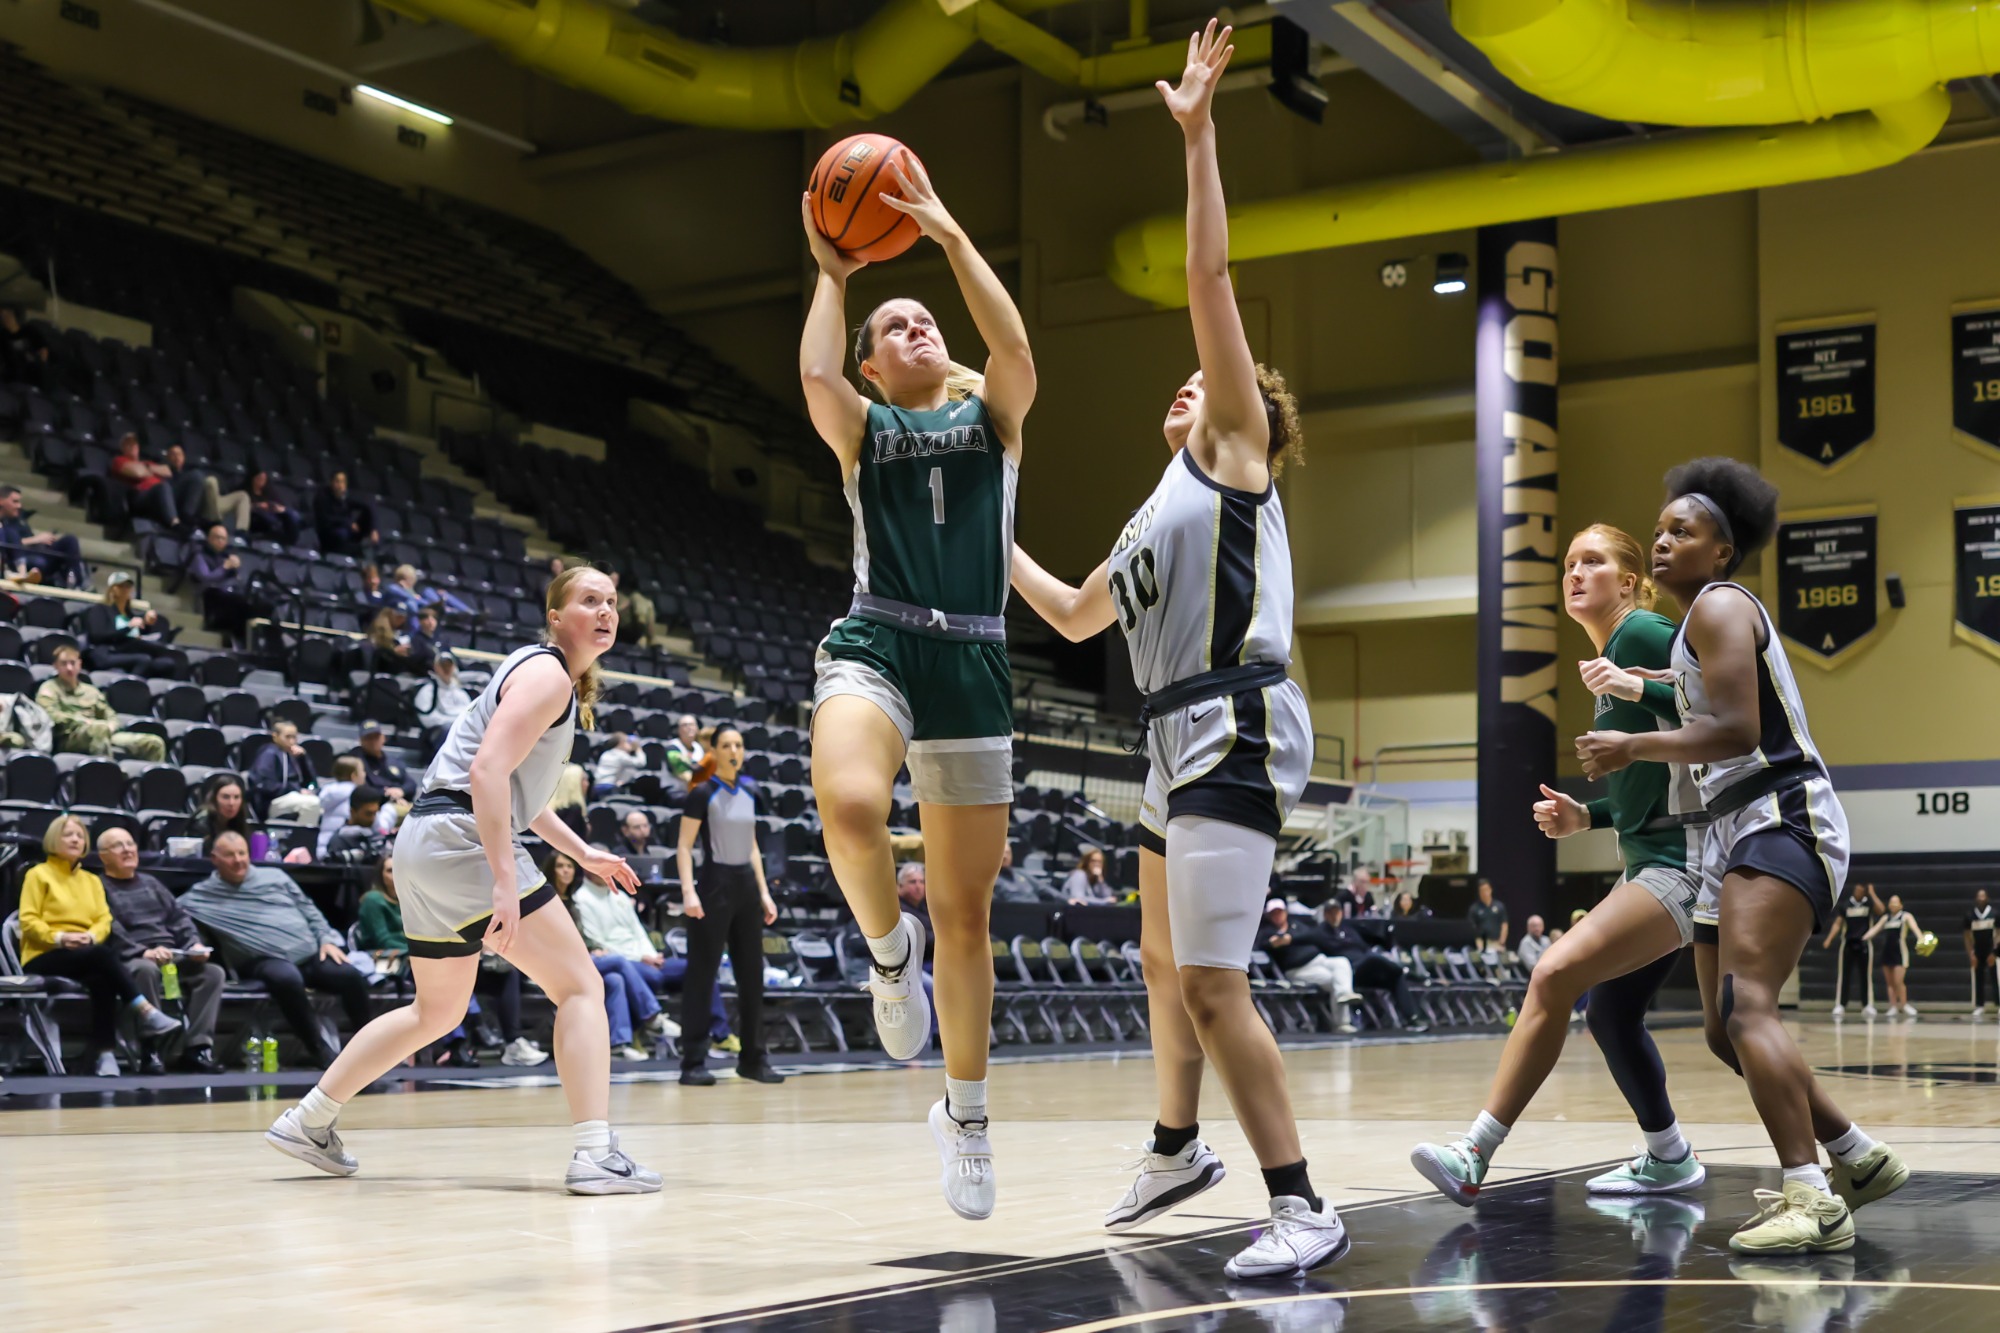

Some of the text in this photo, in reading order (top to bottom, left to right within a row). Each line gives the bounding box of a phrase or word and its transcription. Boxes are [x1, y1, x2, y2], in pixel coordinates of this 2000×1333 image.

[828, 142, 876, 204] ELITE
[1798, 394, 1855, 418] 1961
[874, 424, 988, 464] LOYOLA
[928, 466, 946, 524] 1
[1501, 241, 1558, 731] GO ARMY
[1108, 546, 1160, 632] 30
[1797, 585, 1858, 609] 1966
[1917, 792, 1970, 815] 108
